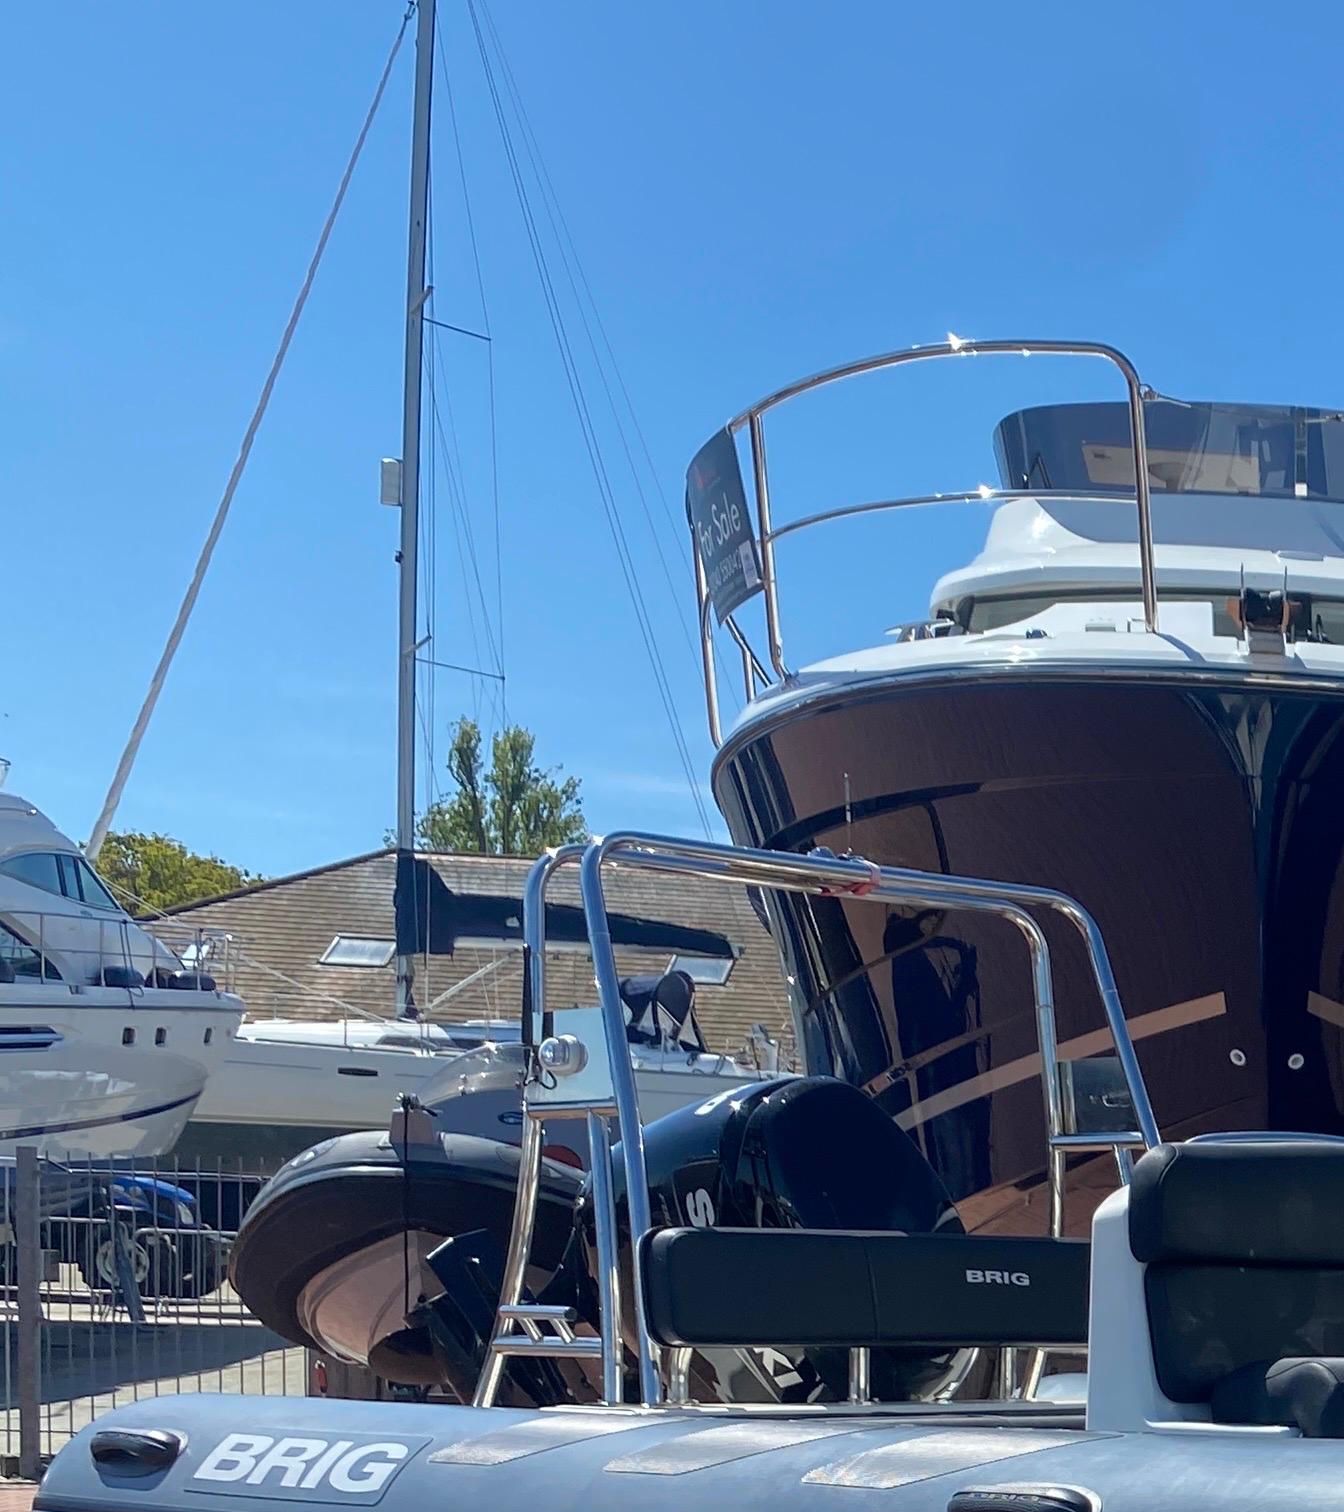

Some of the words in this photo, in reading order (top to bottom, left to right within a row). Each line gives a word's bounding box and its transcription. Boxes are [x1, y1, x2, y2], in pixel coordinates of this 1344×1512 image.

[711, 492, 742, 546] Sale
[966, 1269, 1030, 1287] BRIG
[193, 1433, 409, 1493] BRIG
